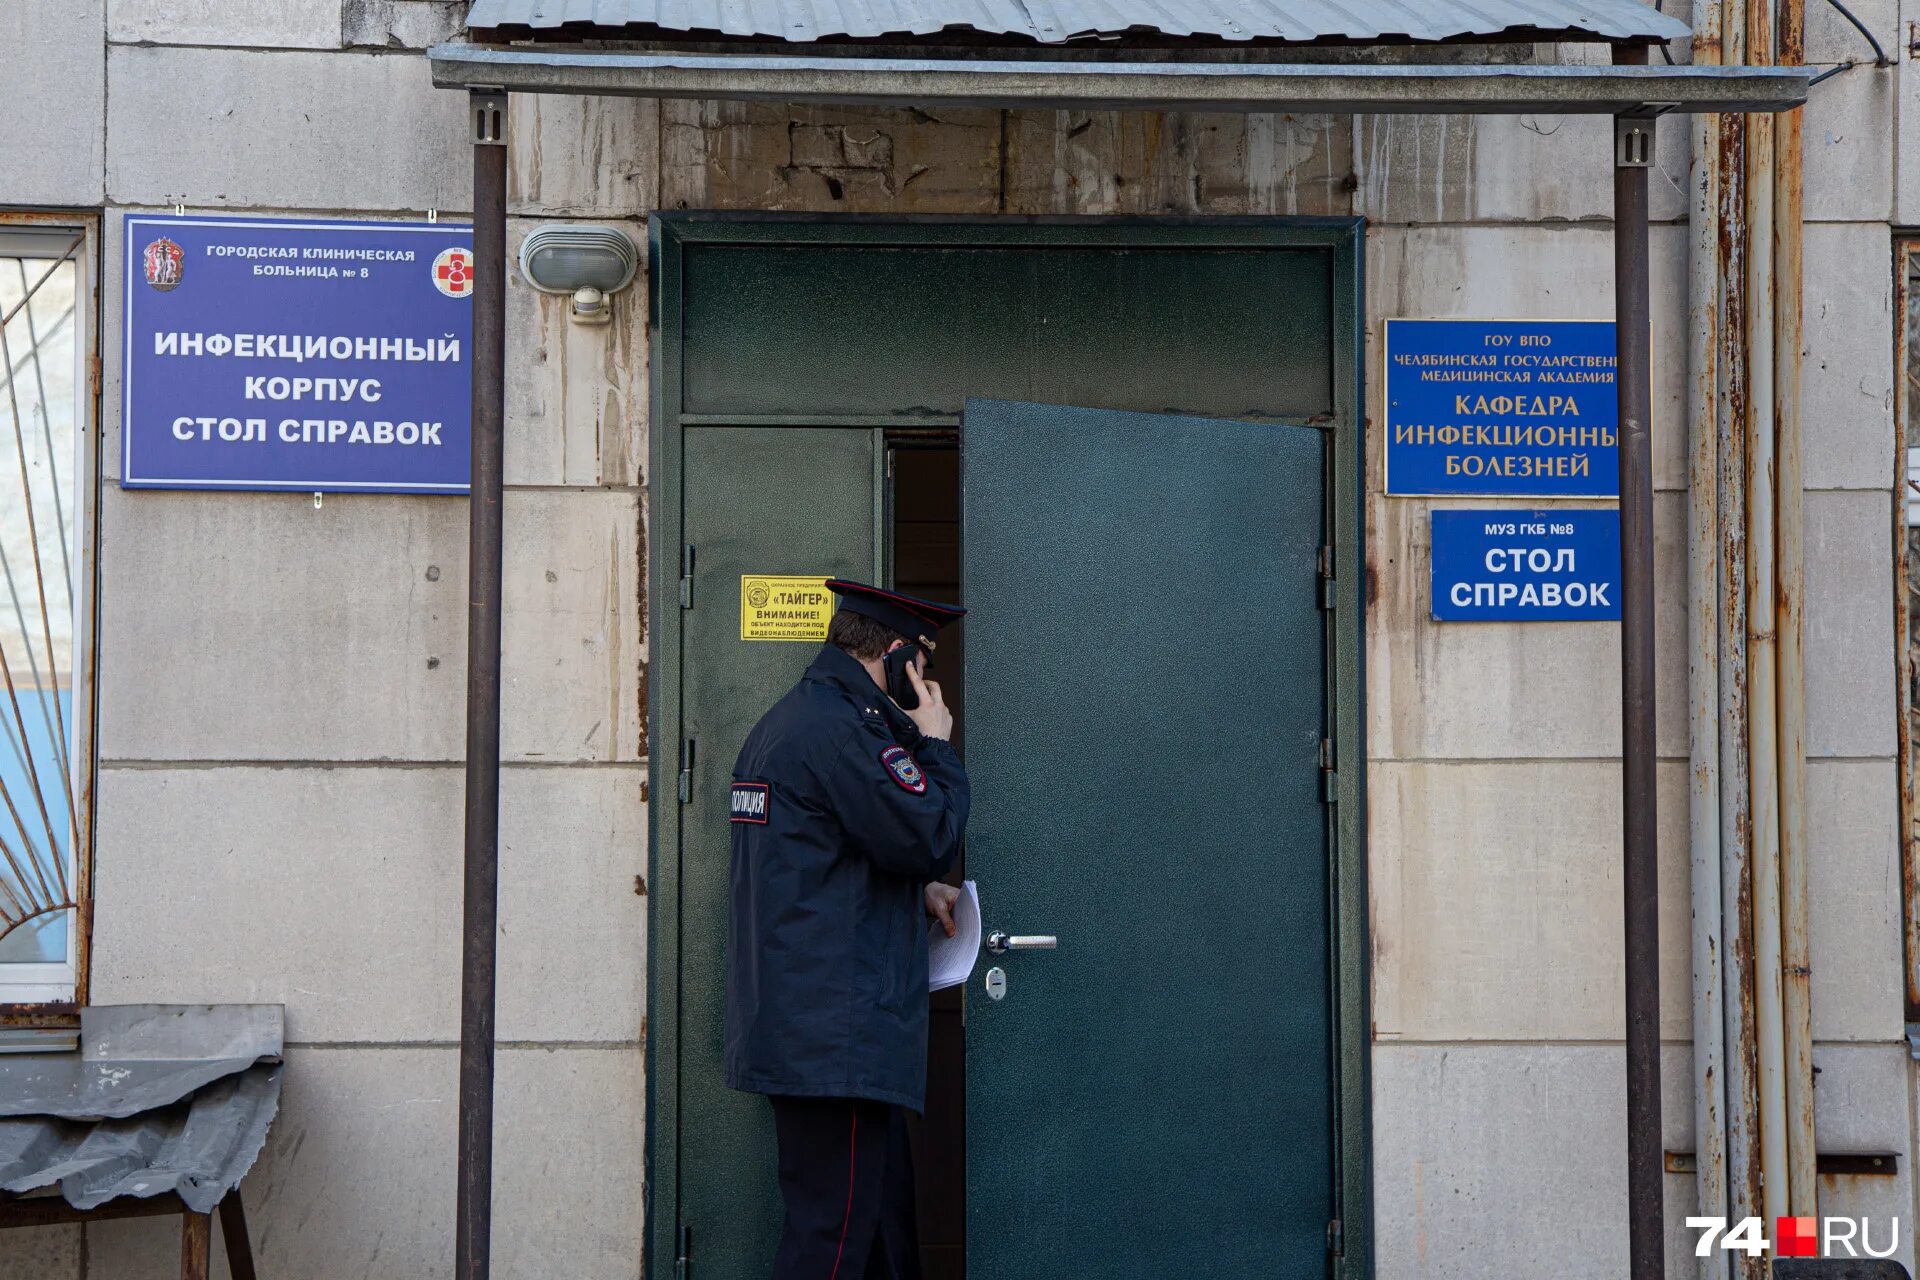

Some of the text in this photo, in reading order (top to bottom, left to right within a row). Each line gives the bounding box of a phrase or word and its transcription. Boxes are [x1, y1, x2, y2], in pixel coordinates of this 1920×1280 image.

[207, 245, 415, 261] ГОРОДСКАЯ КЛИНИЧЕСКАЯ
[253, 265, 369, 279] БОЛЬНИЦА № 8
[154, 332, 460, 363] ИНФЕКЦИОННЫЙ
[1484, 335, 1551, 347] ГОУ ВПО
[1395, 355, 1618, 367] ЧЕЛЯБИНСКАЯ ГОСУДАРСТВЕН
[1421, 371, 1614, 383] МЕДИЦИНСКАЯ АКАДЕМИЯ
[245, 376, 381, 402] КОРПУС
[1455, 395, 1579, 416] КАФЕДРА
[172, 417, 442, 445] СТОЛ СПРАВОК
[1396, 424, 1619, 447] ИНФЕКЦИОННЫ
[1446, 453, 1589, 477] БОЛЕЗНЕЙ
[1485, 523, 1574, 535] МУЗ ГКБ №8
[1485, 548, 1575, 573] СТОЛ
[773, 590, 828, 605] «ТАЙГЕР»
[1451, 582, 1611, 607] СПРАВОК
[756, 610, 820, 620] ВНИМАНИЕ!
